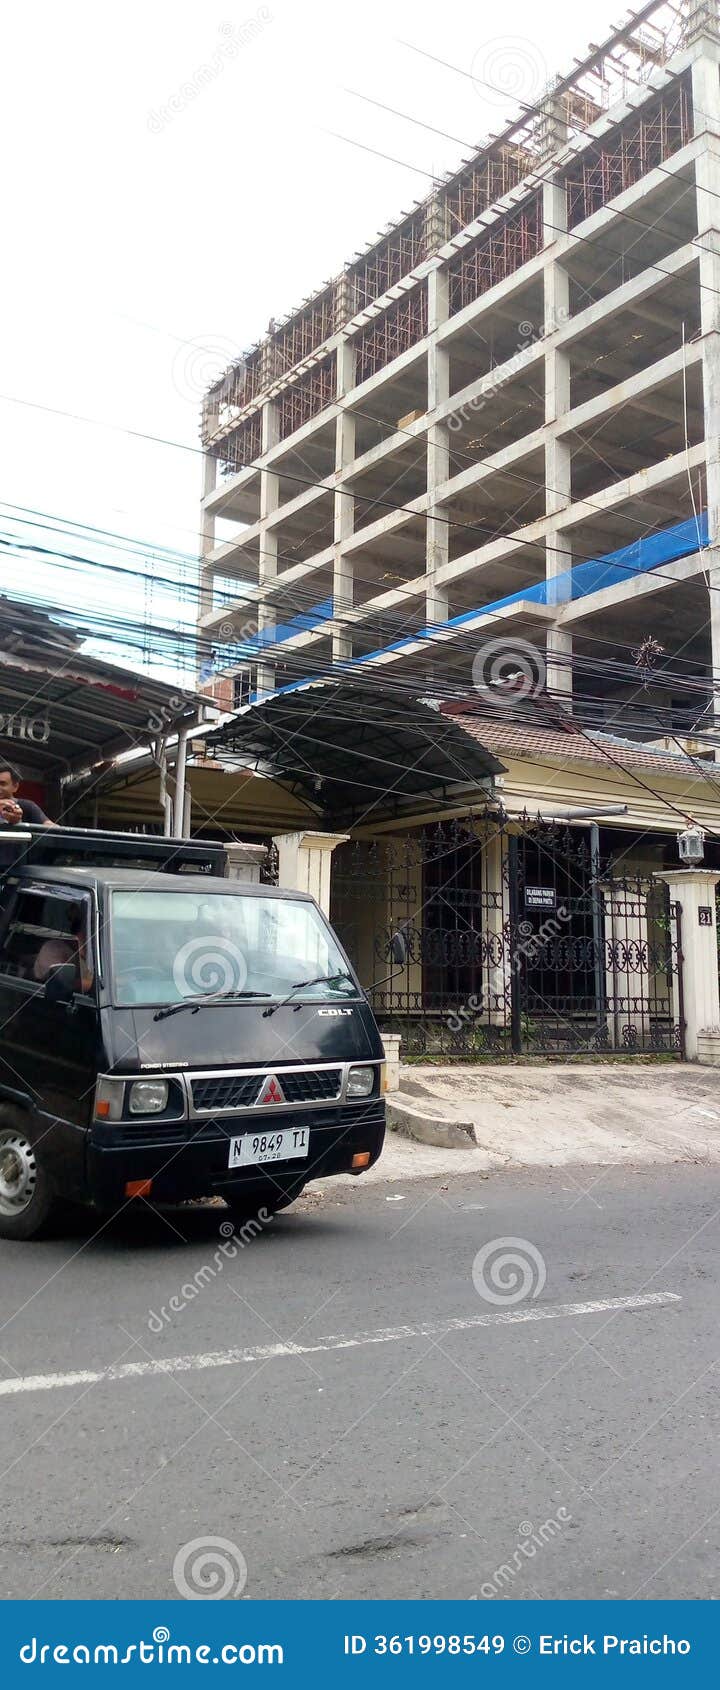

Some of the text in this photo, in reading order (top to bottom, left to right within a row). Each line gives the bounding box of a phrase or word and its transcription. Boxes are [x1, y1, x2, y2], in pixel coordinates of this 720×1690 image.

[700, 912, 711, 924] 21
[234, 1130, 306, 1157] N 9849 TI
